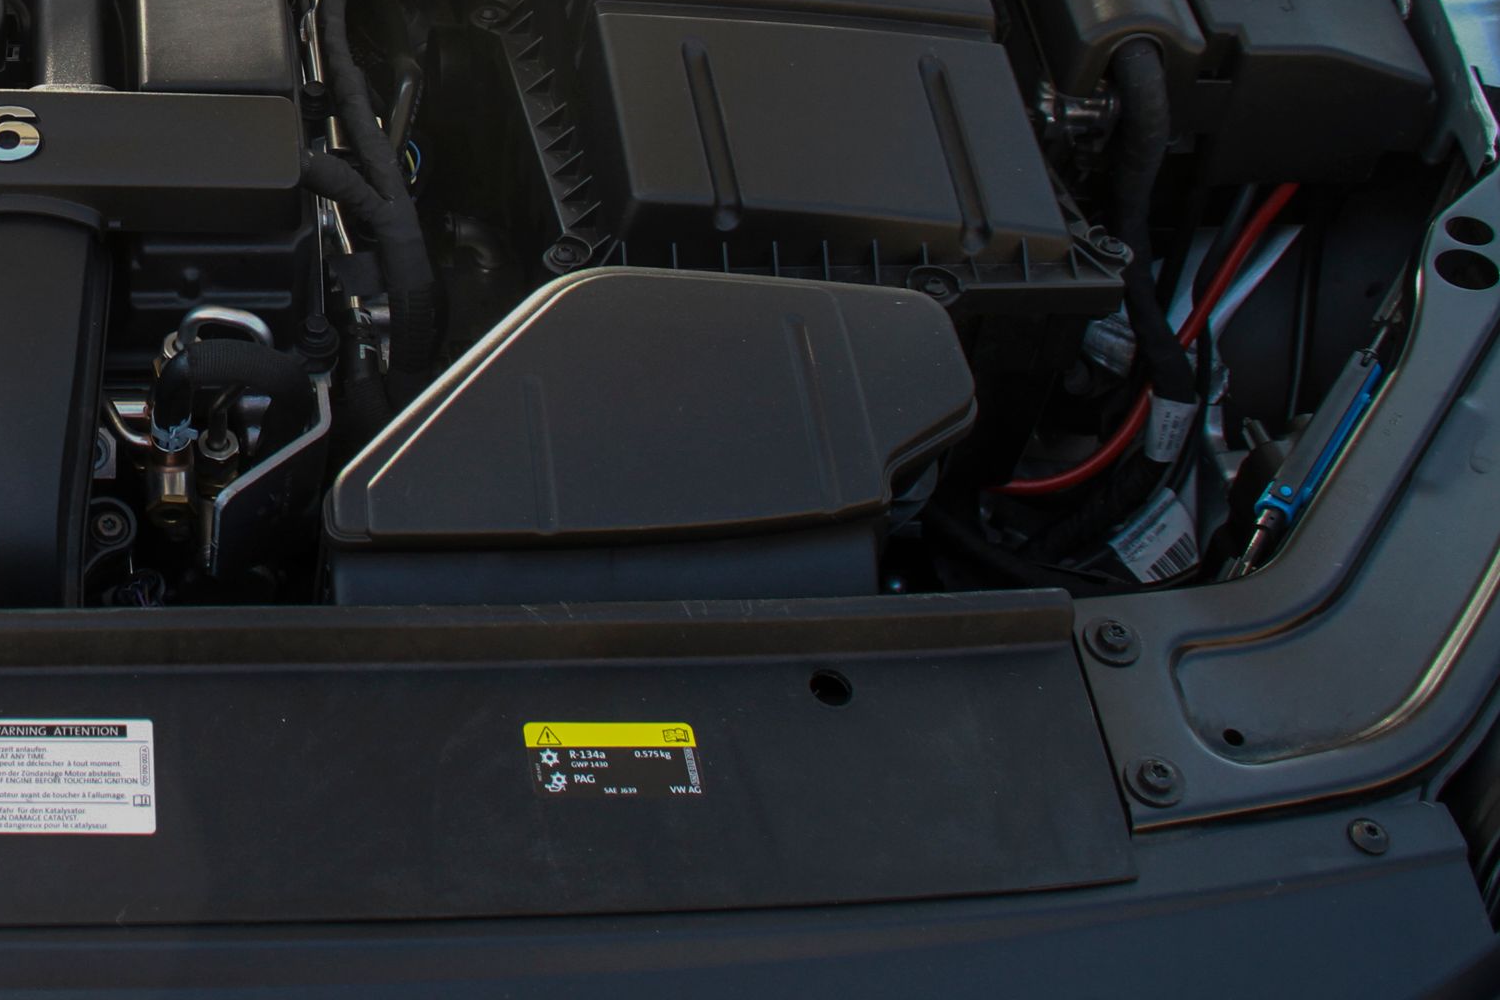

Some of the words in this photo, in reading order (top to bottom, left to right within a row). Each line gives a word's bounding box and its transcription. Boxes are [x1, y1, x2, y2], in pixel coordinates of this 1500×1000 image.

[54, 726, 119, 736] ATTENTION
[569, 750, 606, 759] R-134a
[574, 774, 595, 783] PAG
[604, 786, 617, 794] SAE
[669, 785, 687, 794] VW
[688, 785, 702, 794] AG
